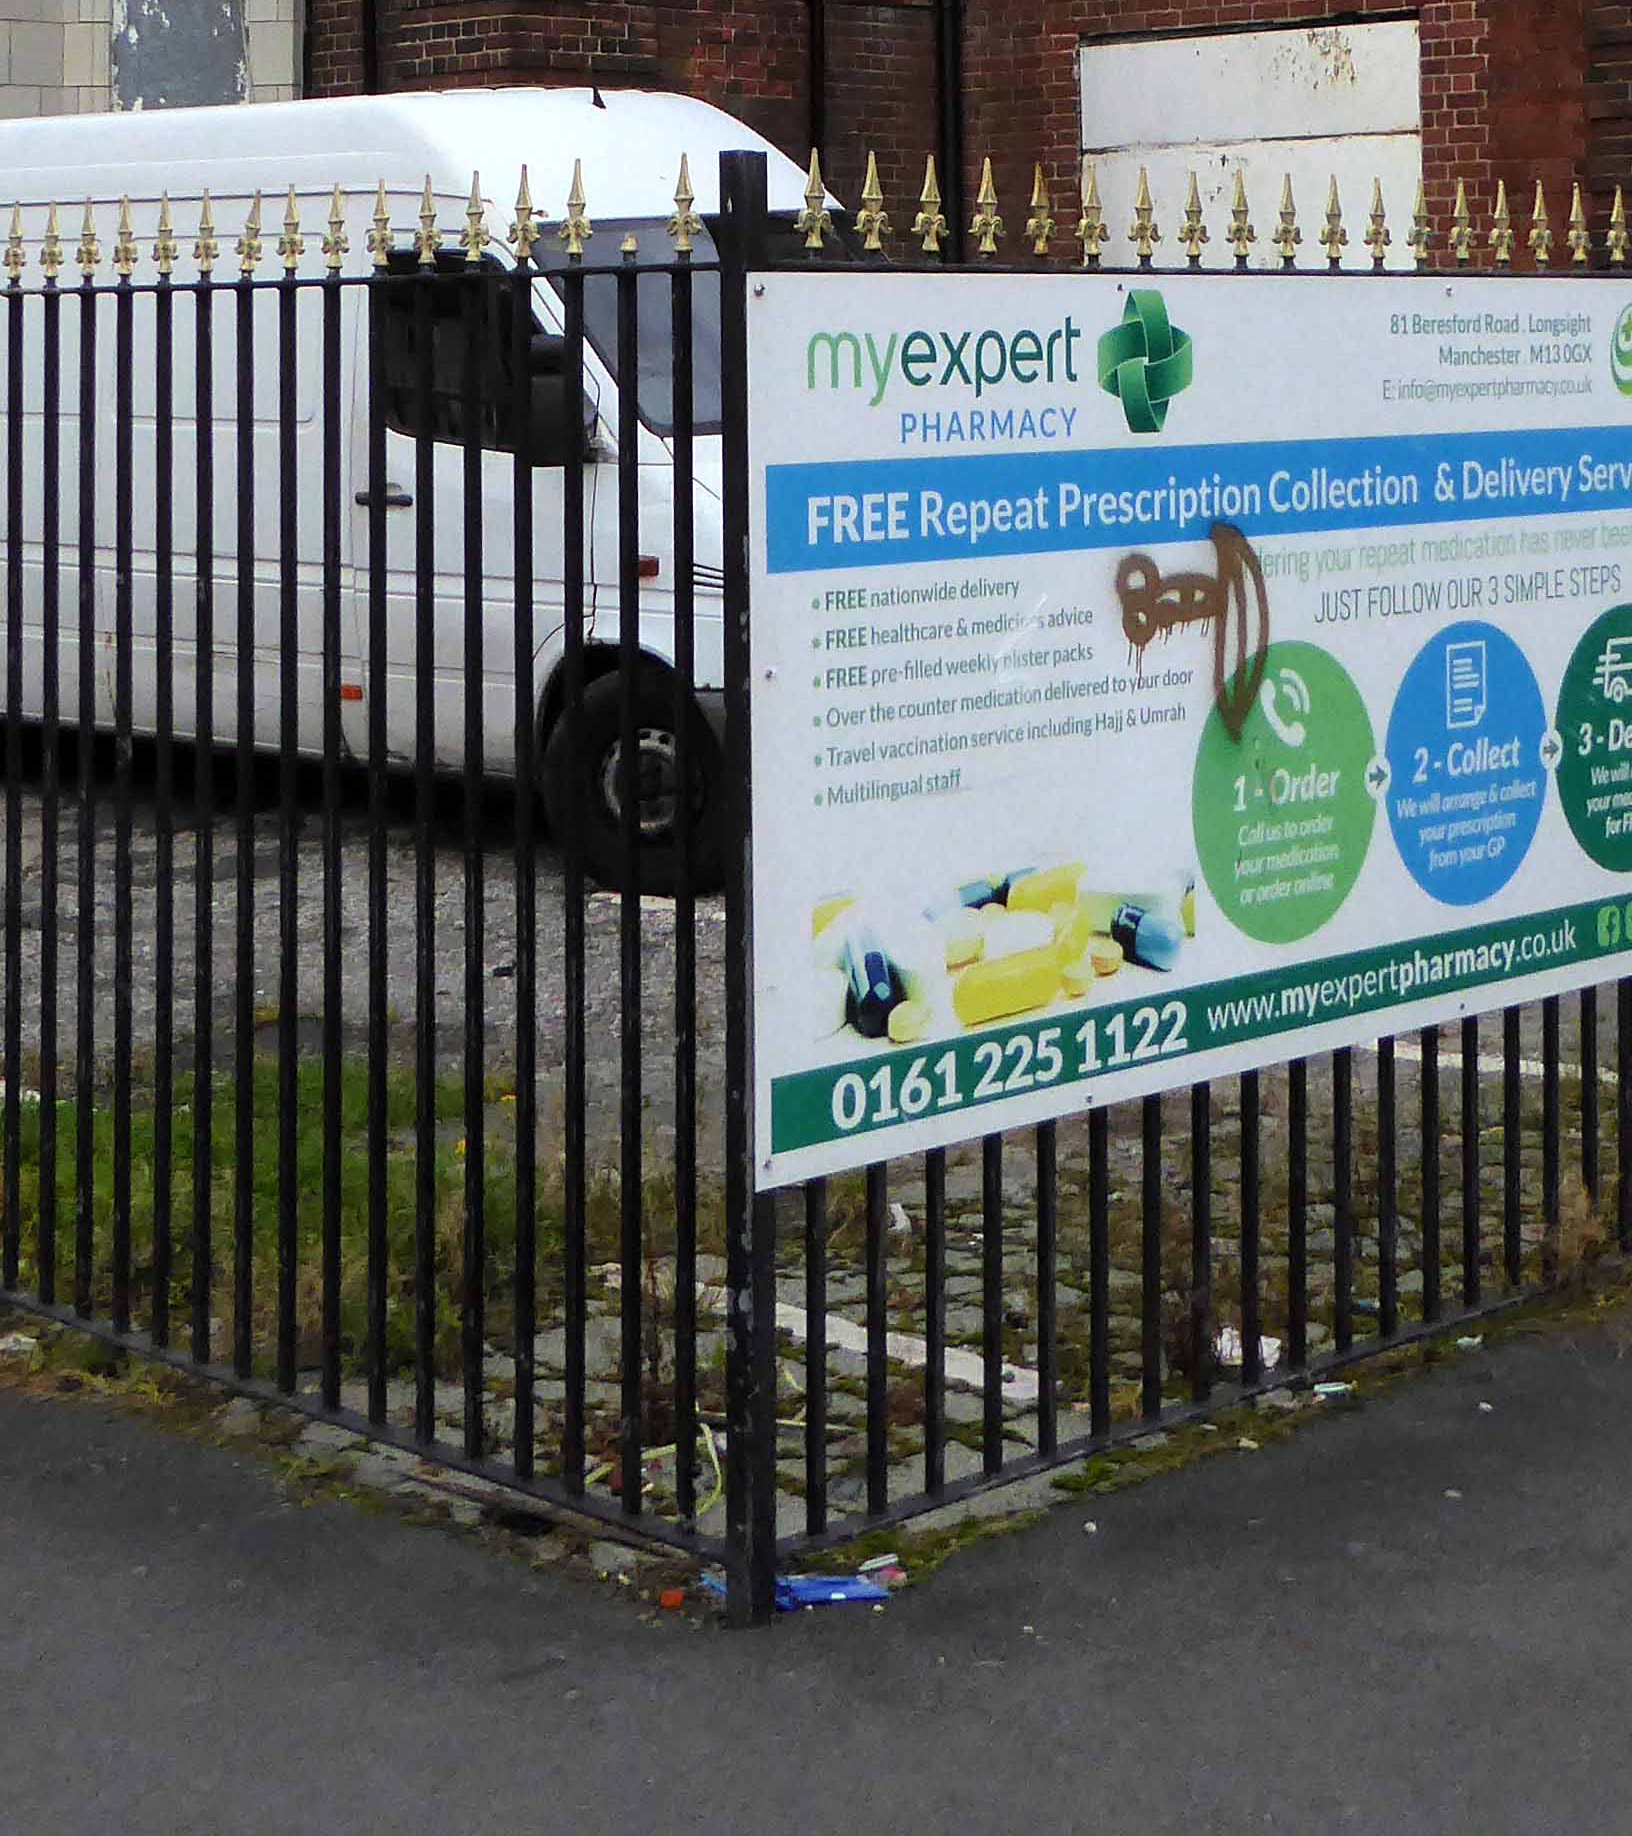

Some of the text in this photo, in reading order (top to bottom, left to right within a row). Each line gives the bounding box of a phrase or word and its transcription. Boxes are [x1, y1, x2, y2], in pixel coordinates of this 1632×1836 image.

[1390, 311, 1592, 337] 81 Beresford Road Longsight
[806, 315, 1081, 407] myexpert
[1439, 343, 1593, 365] Manchester M13 0GX
[900, 407, 1079, 445] PHARMACY
[807, 491, 910, 546] FREE
[919, 485, 1049, 545] Repeat
[1058, 473, 1261, 529] Prescription
[1268, 465, 1418, 514] Collection
[1433, 461, 1456, 503] &
[1462, 455, 1574, 502] Delivery
[1316, 546, 1353, 576] your
[1359, 538, 1417, 574] repeat
[1422, 525, 1517, 563] medication
[1519, 526, 1549, 555] has
[1554, 526, 1599, 551] never
[825, 577, 1021, 612] FREE nationwide delivery
[1314, 563, 1622, 624] JUST FOLLOW OUR 3 SIMPLE STEPS
[825, 607, 1094, 651] FREE healthcare & medicis advice
[825, 665, 868, 690] FREE
[871, 660, 943, 688] pre-filled
[945, 651, 999, 676] weekly
[1052, 643, 1094, 668] packs
[826, 668, 1195, 729] Over the counter medication delivered to your door
[826, 702, 1186, 768] Travel vaccination service including Hajj & Umrah
[1577, 722, 1593, 756] 3
[1412, 747, 1429, 784] 2
[1447, 735, 1521, 777] Collect
[1590, 766, 1610, 786] We
[1611, 760, 1630, 782] will
[827, 767, 962, 808] Multilingual staff
[1232, 775, 1247, 812] 1
[1269, 762, 1341, 805] Order
[1396, 797, 1418, 819] We
[1419, 792, 1441, 814] will
[1442, 790, 1488, 813] arrange
[1500, 779, 1537, 800] collect
[1586, 797, 1611, 818] your
[1605, 816, 1622, 839] for
[1238, 813, 1334, 846] Call us to order
[1420, 810, 1517, 847] your prescription
[1235, 842, 1341, 882] your medication
[1429, 835, 1506, 873] from your GP
[1240, 889, 1255, 905] or
[1255, 877, 1293, 904] order
[831, 918, 1577, 1131] 0161 225 1122 www.myexpertpharmacy.co.uk
